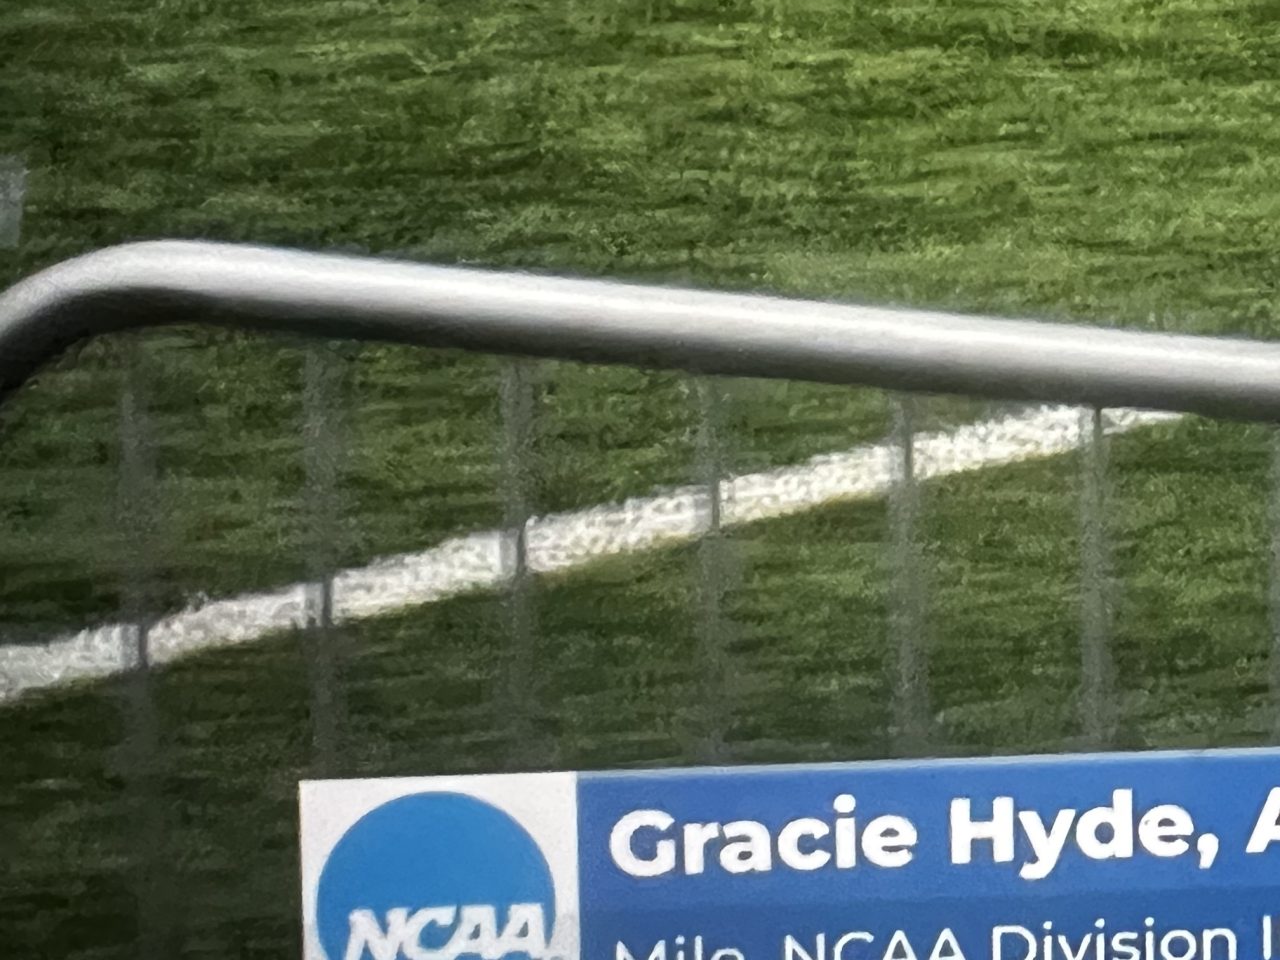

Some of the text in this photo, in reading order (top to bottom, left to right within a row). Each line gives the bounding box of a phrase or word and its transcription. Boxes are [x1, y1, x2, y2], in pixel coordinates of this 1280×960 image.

[608, 793, 918, 877] Gracie
[949, 788, 1220, 881] Hyde,
[344, 902, 550, 960] NCAA
[784, 927, 966, 960] NCAA
[991, 916, 1238, 960] Division
